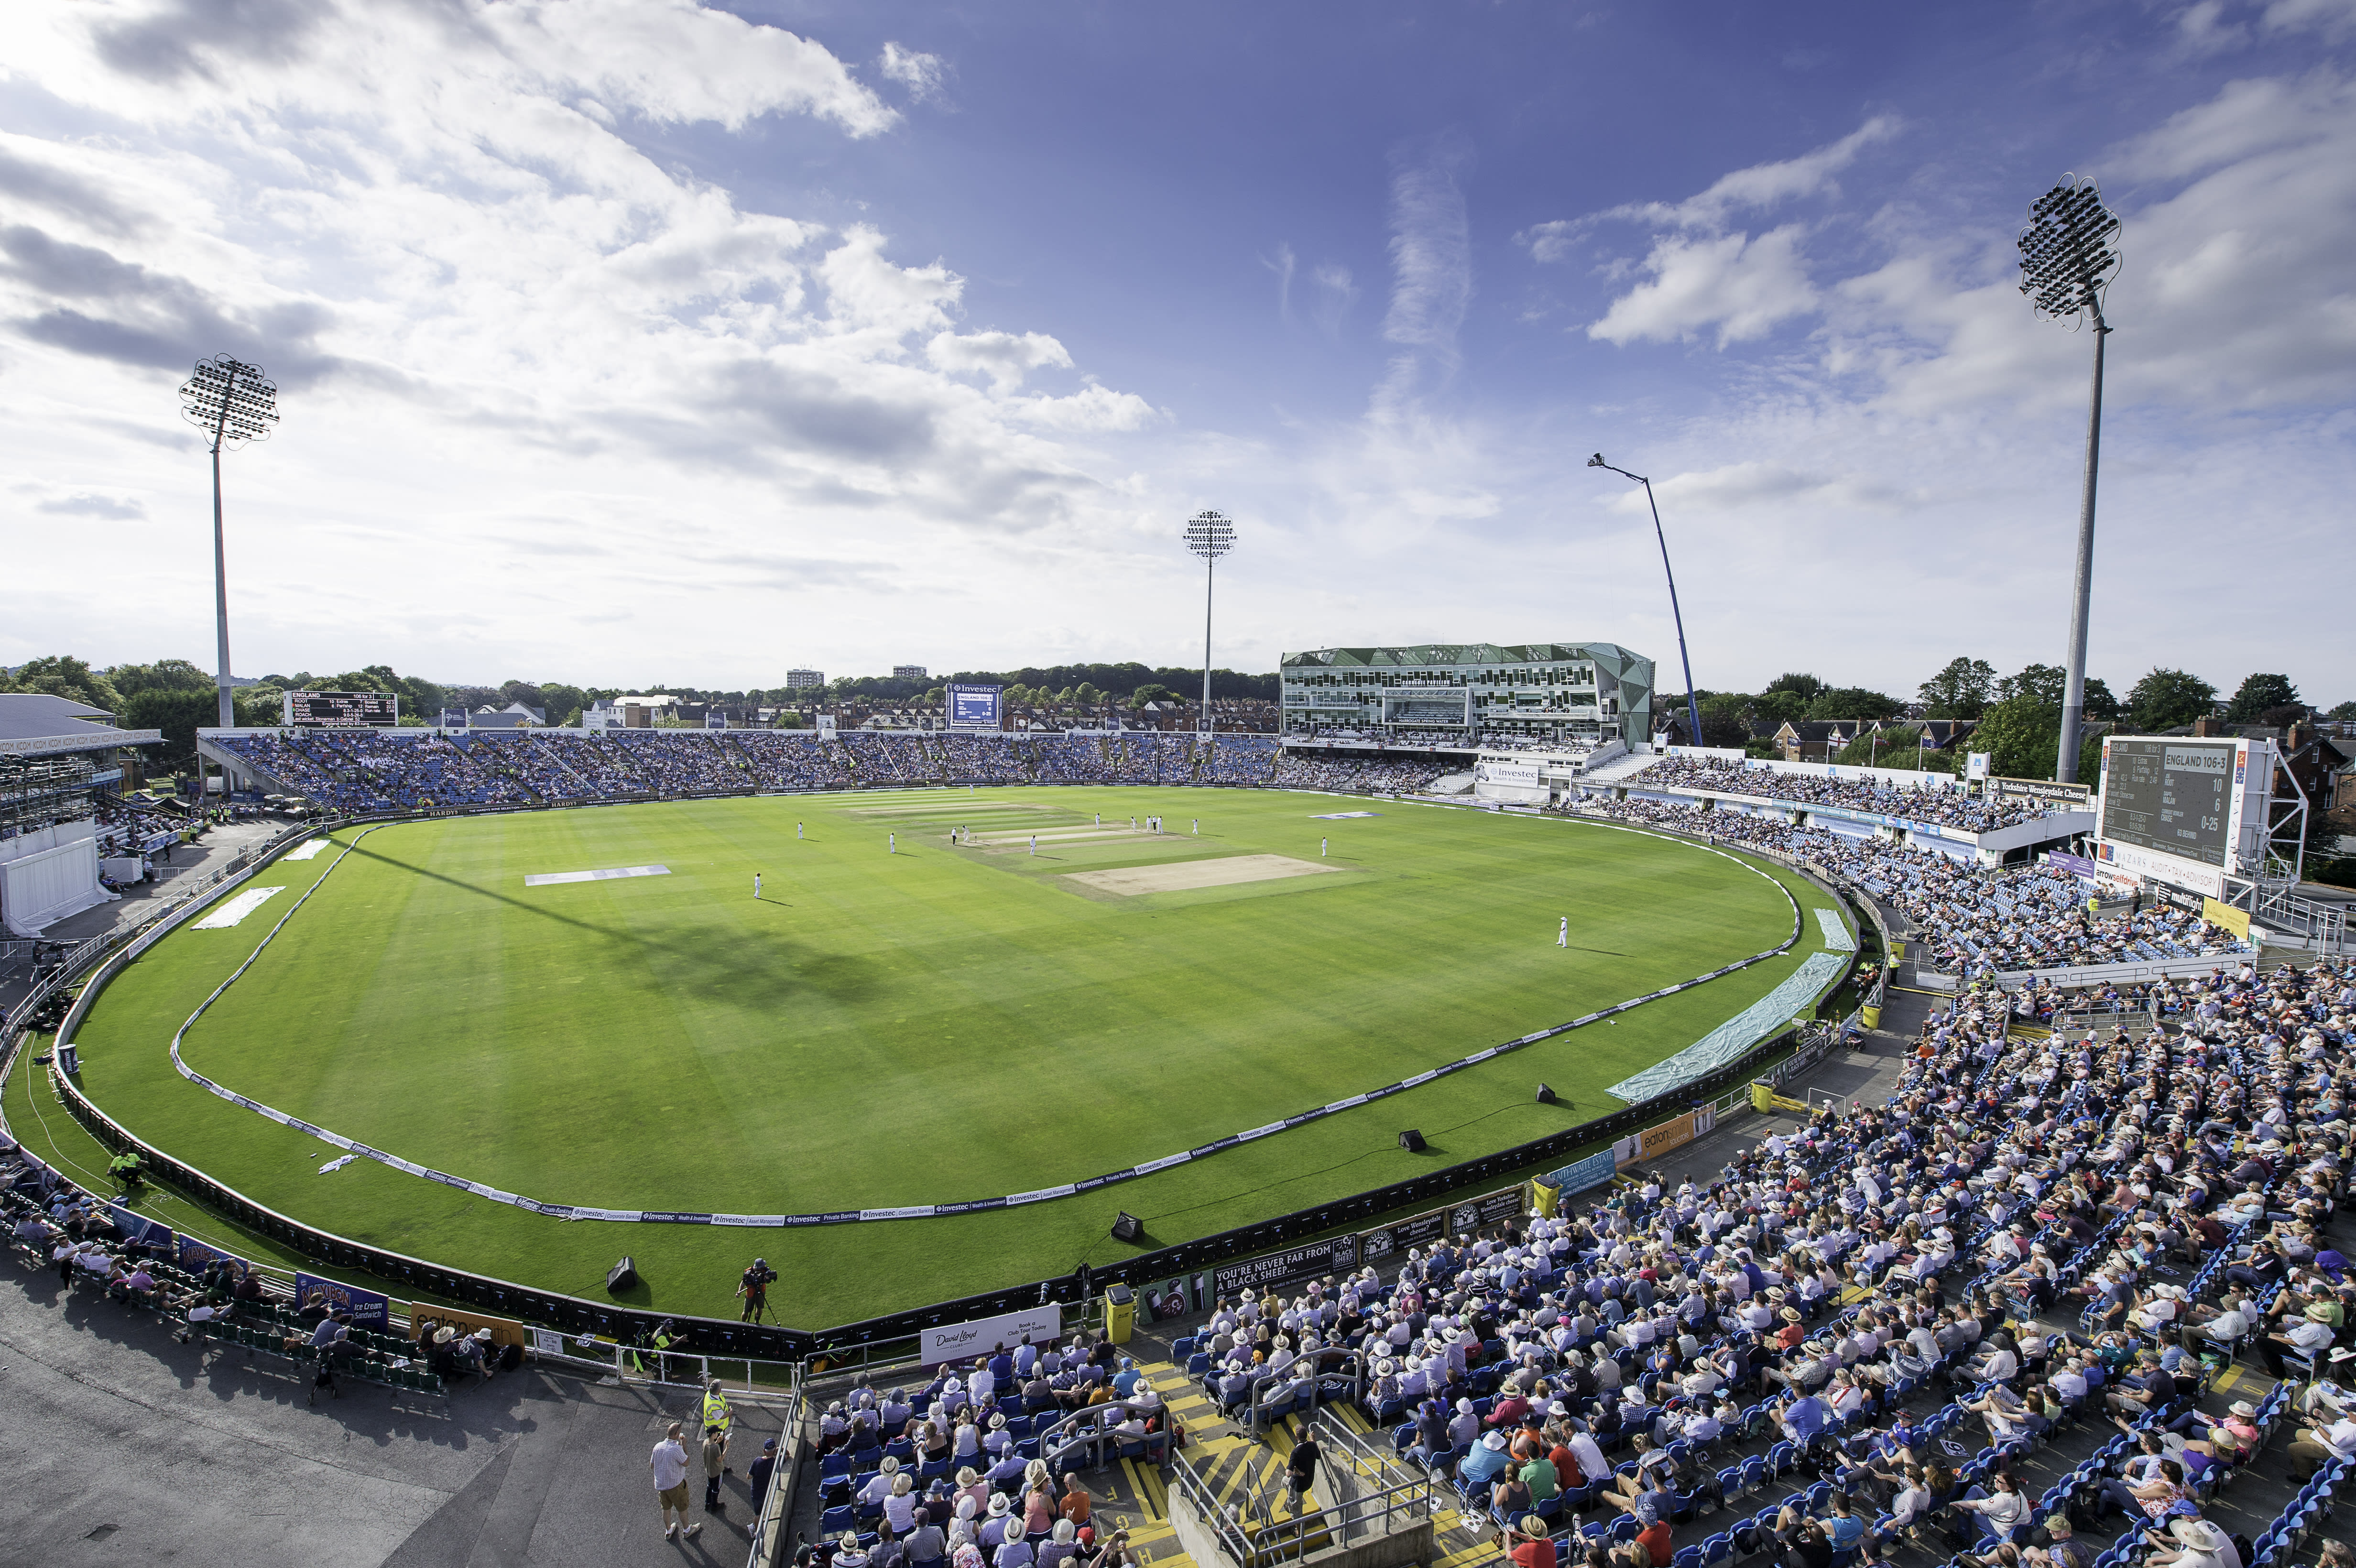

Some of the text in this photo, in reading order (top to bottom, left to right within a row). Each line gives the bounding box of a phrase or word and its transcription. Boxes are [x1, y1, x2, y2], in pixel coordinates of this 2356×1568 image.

[16, 741, 31, 751] KCOM
[2166, 754, 2225, 769] ENGLAND 106-3
[1499, 768, 1536, 778] Investec
[2002, 782, 2086, 799] Yorkshire Wensleydale Cheese
[2213, 778, 2223, 792] 10
[2162, 796, 2176, 805] MALAN
[2215, 798, 2220, 812] 6
[2161, 814, 2173, 823] CHASE
[2201, 816, 2218, 831] 0-25
[2182, 829, 2197, 839] BEHIND
[2116, 852, 2146, 867] MAZARS
[2096, 869, 2138, 887] arrowselfdrive
[2151, 861, 2217, 888] AUDIT TAX ADVISORY
[2171, 892, 2203, 912] multiflight
[169, 915, 181, 928] Investec
[65, 1052, 73, 1072] Strathmore
[1645, 1120, 1689, 1148] eatonsmith
[1669, 1132, 1689, 1146] SOLICITORS
[1196, 1145, 1215, 1155] Investec
[1141, 1162, 1163, 1172] Investec
[1178, 1154, 1190, 1162] Banking
[1552, 1160, 1592, 1183] RAITHWAITE
[1592, 1151, 1613, 1165] ESTATE
[1081, 1178, 1104, 1188] Investec
[1120, 1170, 1134, 1179] Banking
[1560, 1173, 1614, 1198] www.raithwaiteestate.com
[1567, 1181, 1579, 1189] HOTELS
[1582, 1173, 1598, 1183] COTTAGES
[1014, 1193, 1039, 1202] Investec
[1053, 1187, 1074, 1196] Management
[1496, 1193, 1515, 1202] Yorkshire
[1480, 1201, 1505, 1213] Wensleydale
[1506, 1196, 1521, 1206] cheese?
[579, 1209, 605, 1217] Investec
[1452, 1203, 1479, 1227] WENSLEYDALE
[1397, 1215, 1441, 1233] Love Wensleydale
[1410, 1225, 1429, 1236] cheese?
[1453, 1221, 1478, 1233] CREAMERY
[1364, 1230, 1393, 1254] WENSLEYDALE
[1335, 1249, 1353, 1258] BLACK
[1335, 1254, 1353, 1263] SHEEP
[1364, 1249, 1393, 1262] CREAMERY
[1216, 1245, 1331, 1282] YOU'RE NEVER FAR FROM
[1217, 1266, 1296, 1291] A BLACK SHEEP...
[301, 1283, 351, 1308] MAXIBON
[354, 1302, 382, 1311] Ice Cream
[354, 1311, 381, 1319] Sandwich
[1032, 1324, 1047, 1332] Today
[936, 1329, 978, 1347] David Lloyd
[1137, 1548, 1153, 1563] H
